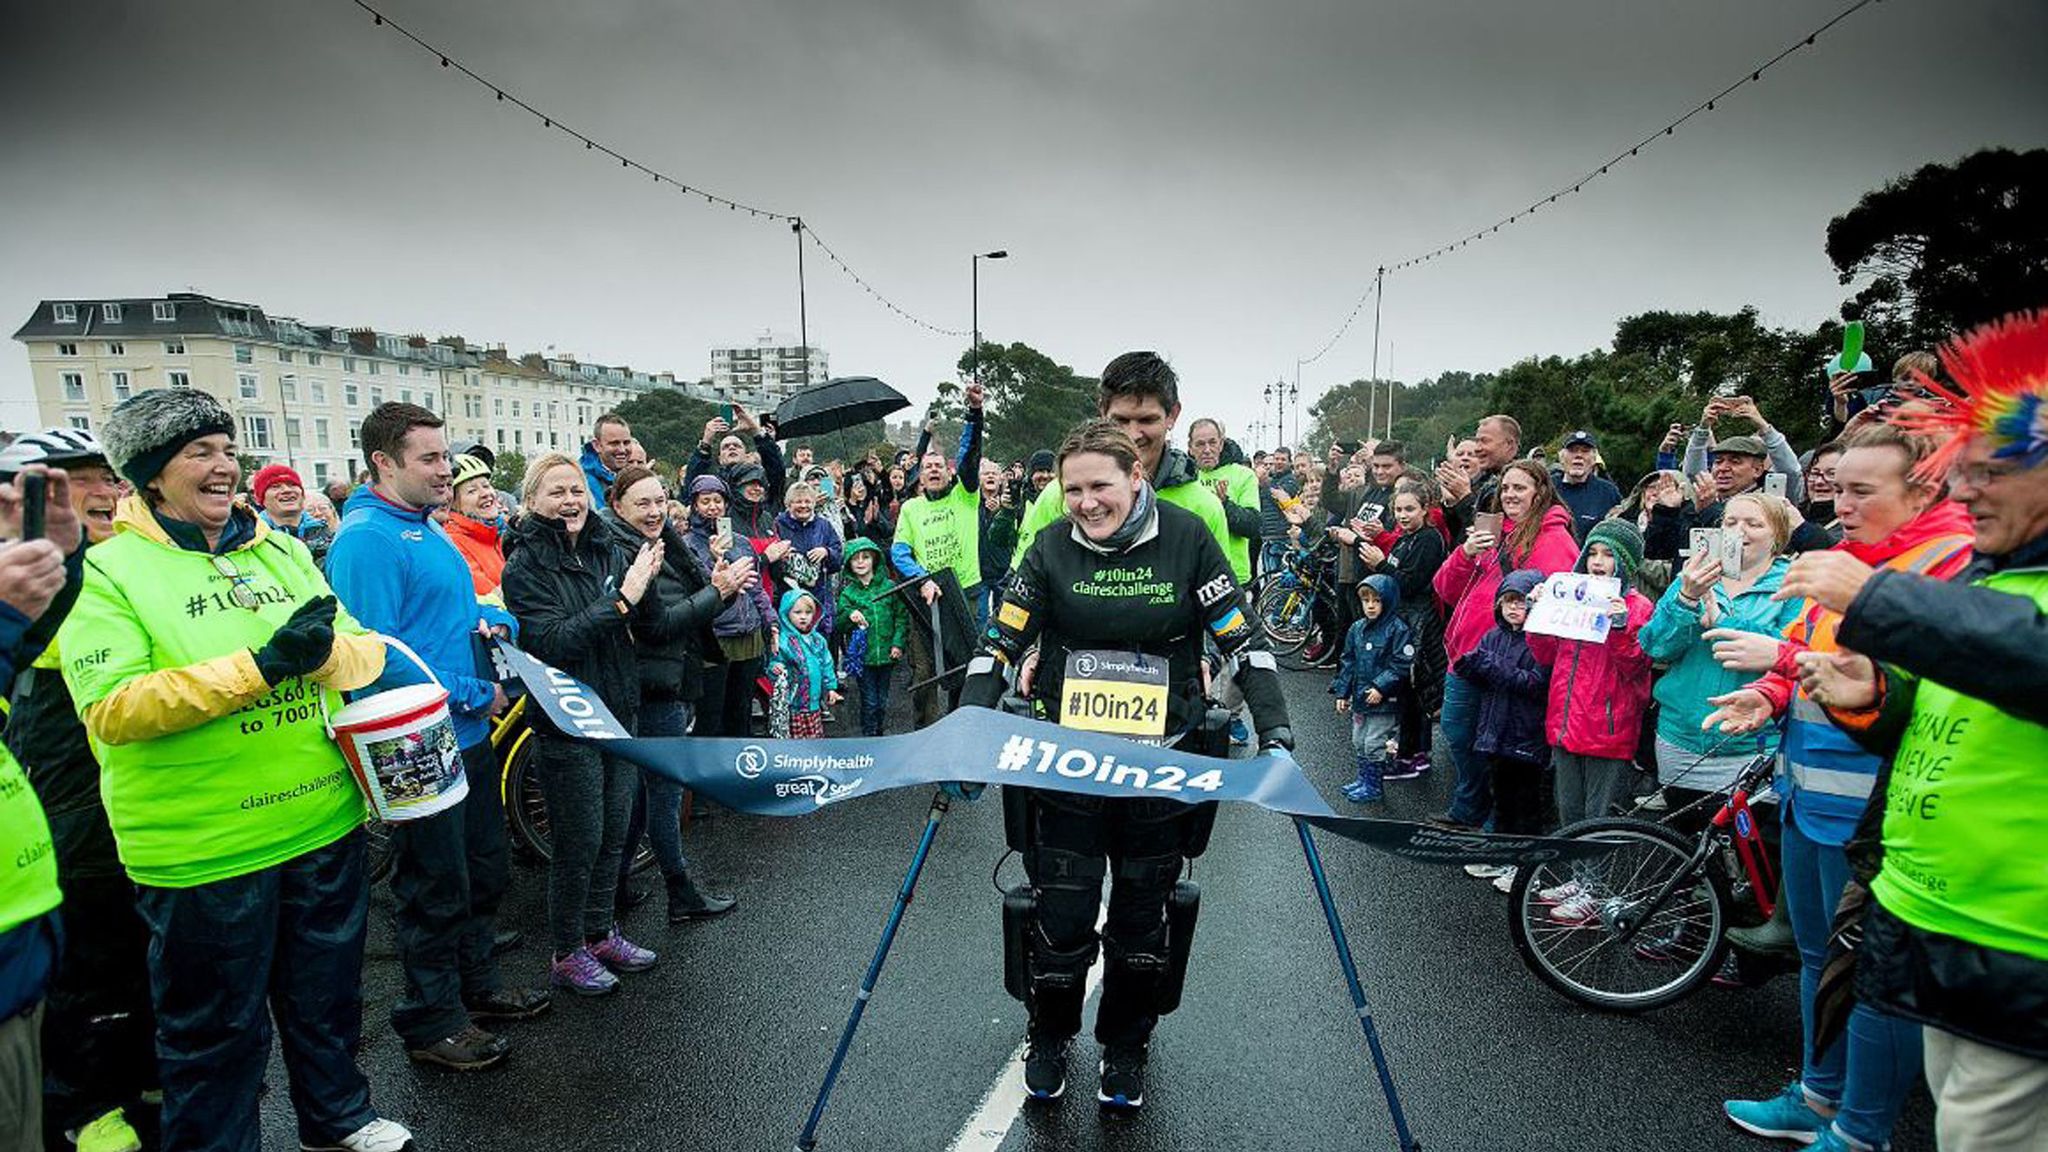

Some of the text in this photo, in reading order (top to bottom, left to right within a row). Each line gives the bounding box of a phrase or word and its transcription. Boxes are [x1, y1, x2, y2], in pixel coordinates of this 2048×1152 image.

[1093, 566, 1154, 581] #10in24
[1072, 580, 1174, 597] claireschallenge
[1068, 691, 1159, 722] #10in24
[240, 719, 264, 735] to
[773, 753, 875, 773] Simplyhealth
[996, 733, 1225, 793] #10in24
[774, 780, 816, 798] great
